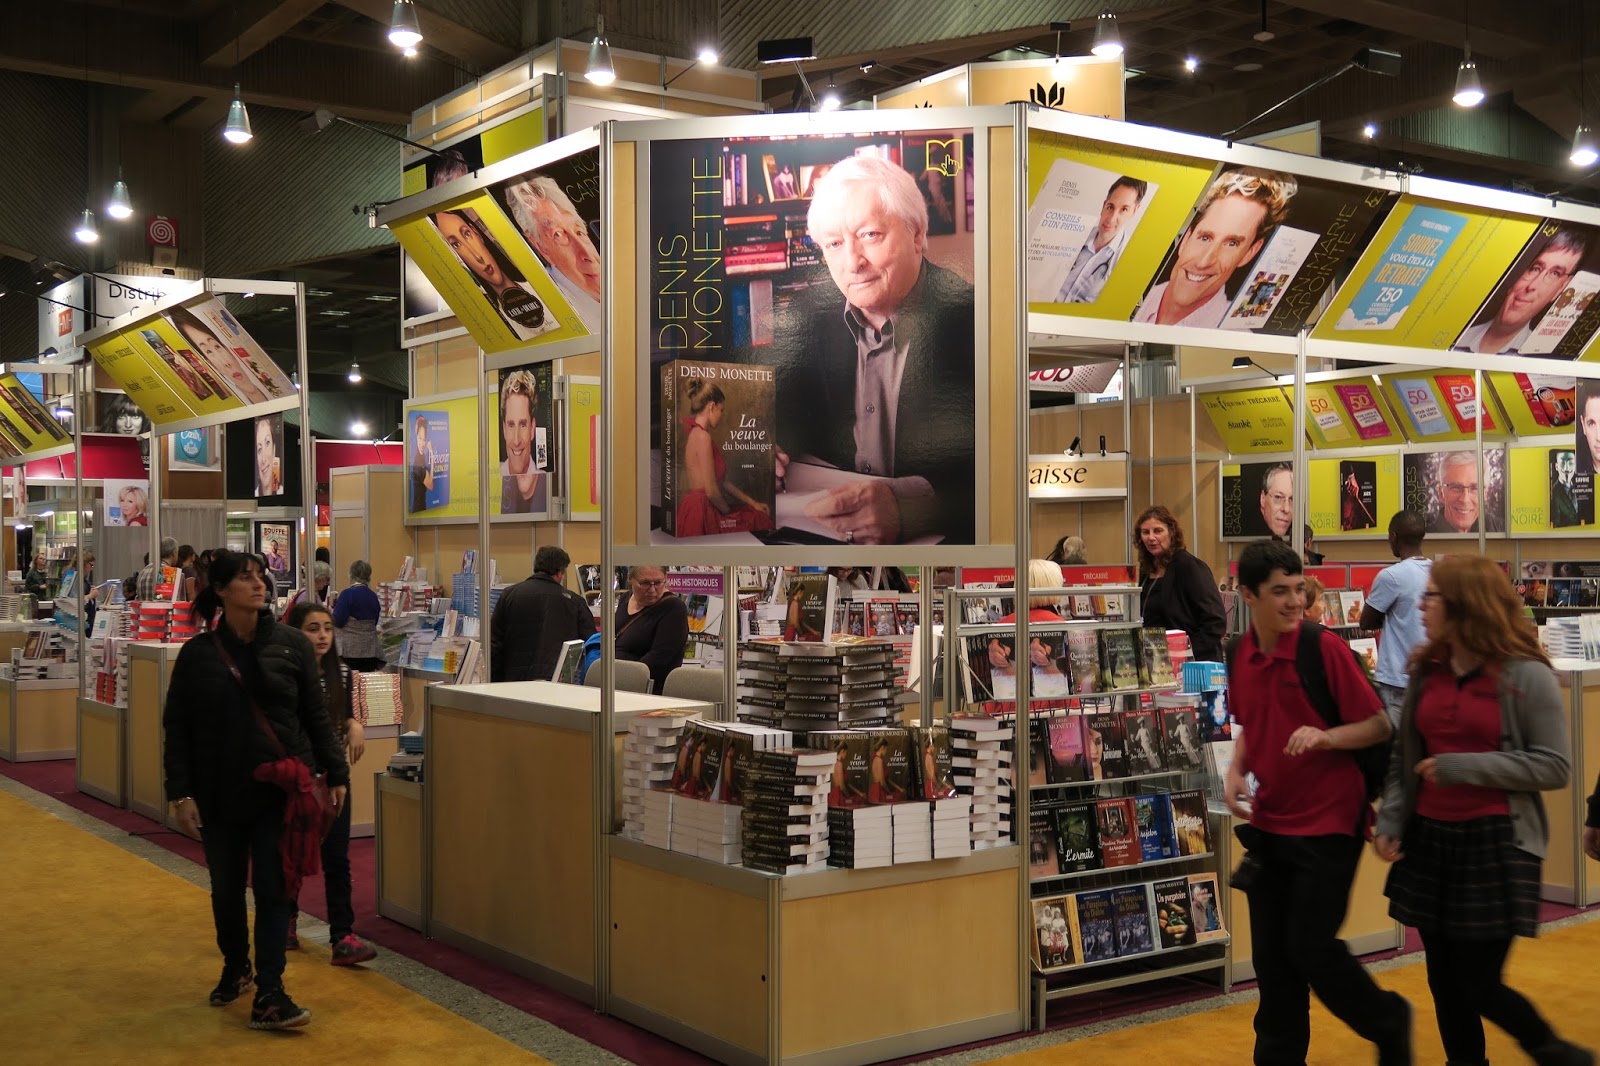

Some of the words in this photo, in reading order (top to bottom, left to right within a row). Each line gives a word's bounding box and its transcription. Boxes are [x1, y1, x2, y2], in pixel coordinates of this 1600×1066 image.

[1045, 211, 1081, 223] CONSEILS
[1060, 222, 1085, 232] PHYSIO
[692, 156, 723, 349] MONETTE
[1389, 252, 1408, 263] VOUS
[1426, 259, 1435, 267] LA
[1281, 231, 1357, 332] LAPOINTE
[658, 234, 688, 349] DENIS
[1375, 286, 1404, 303] 750
[680, 365, 716, 379] DENIS
[720, 367, 773, 382] MONETTE
[1407, 389, 1428, 405] 50
[1451, 384, 1474, 402] 50
[1309, 397, 1329, 413] 50
[1349, 394, 1371, 411] 50
[739, 413, 757, 428] La
[729, 430, 766, 441] veuve
[666, 445, 671, 456] du
[722, 441, 733, 451] du
[734, 441, 773, 453] boulanger
[1029, 464, 1087, 484] aisse
[664, 486, 671, 500] La
[1233, 478, 1242, 535] GAGNON
[1511, 513, 1545, 525] NOIRE
[682, 578, 719, 588] HISTORIQUES
[1091, 720, 1118, 729] MONETTE
[893, 749, 902, 757] La
[1065, 848, 1095, 862] L'ermite
[1156, 893, 1165, 903] Un
